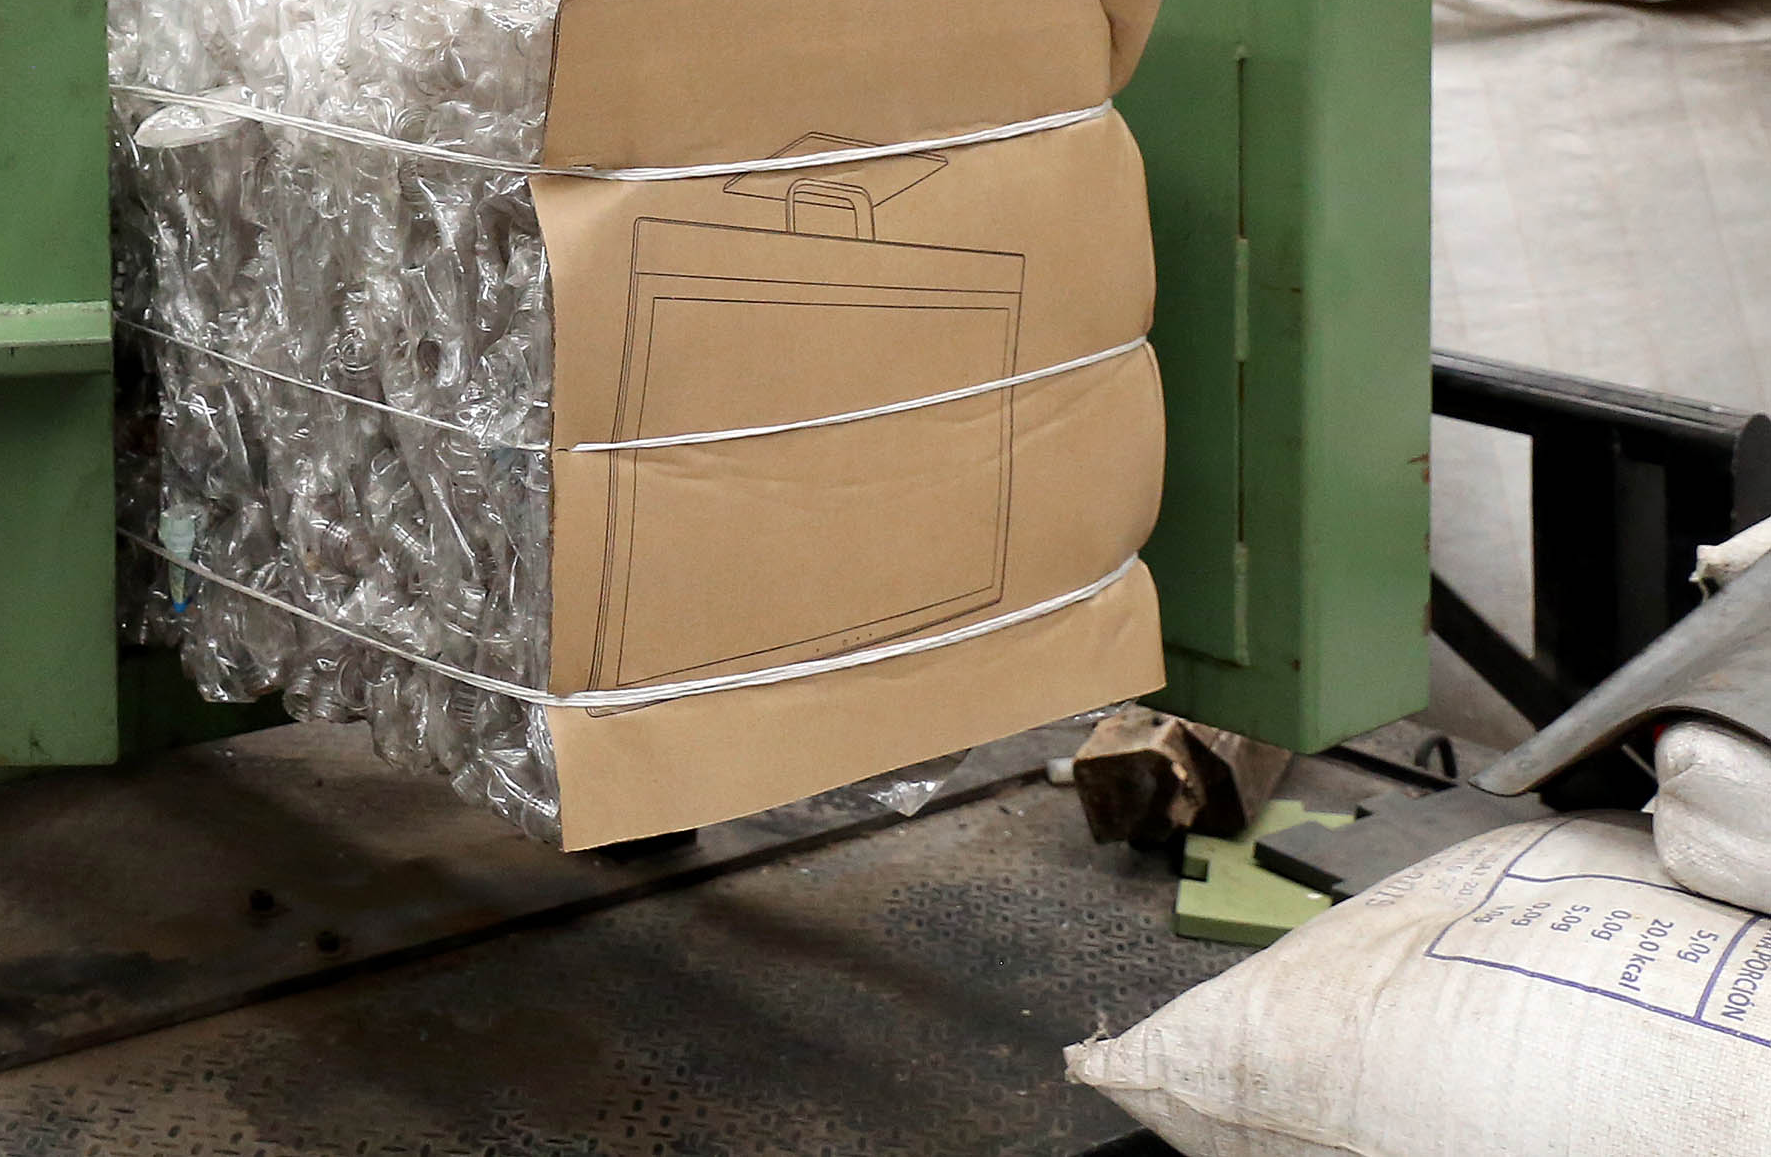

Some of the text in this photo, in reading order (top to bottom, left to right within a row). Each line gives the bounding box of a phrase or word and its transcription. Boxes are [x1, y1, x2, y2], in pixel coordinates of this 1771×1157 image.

[1511, 902, 1551, 927] 0,0g
[1551, 904, 1591, 932] 5,0g
[1590, 909, 1632, 941] 0,0g
[1619, 918, 1674, 991] 20,0 kcal
[1677, 929, 1720, 963] 5,0g
[1721, 949, 1771, 1022] PORCIÓN
